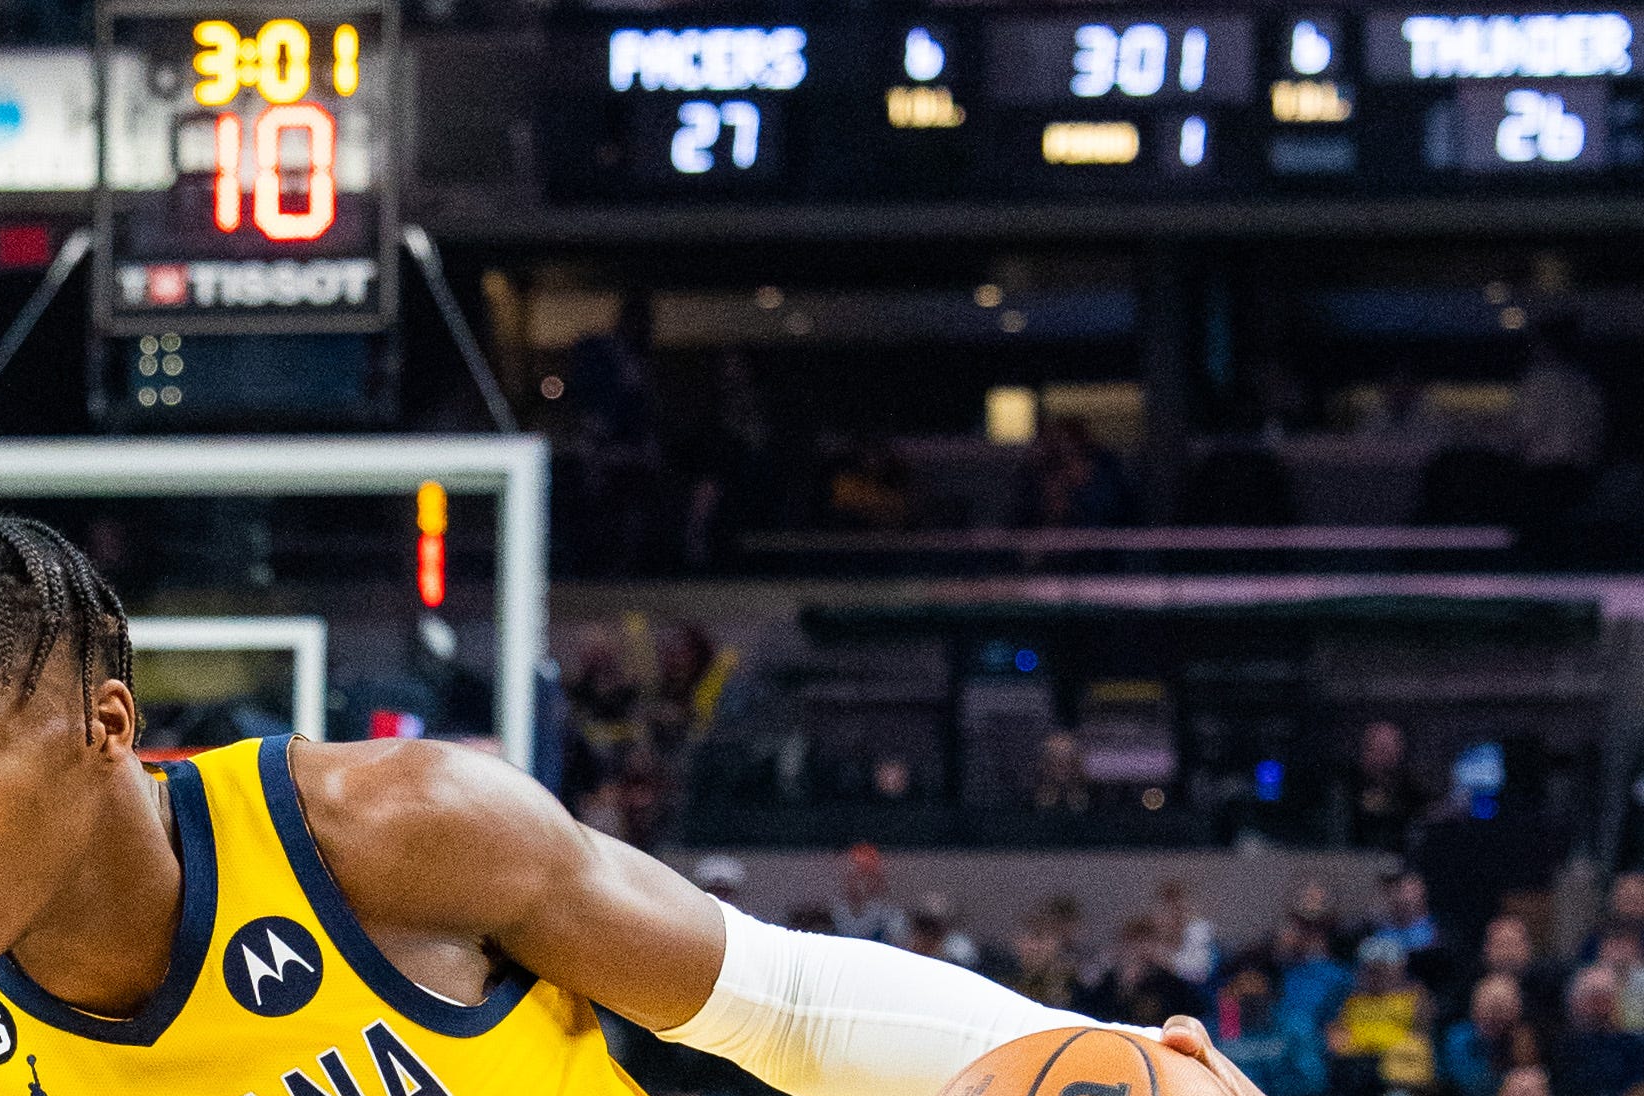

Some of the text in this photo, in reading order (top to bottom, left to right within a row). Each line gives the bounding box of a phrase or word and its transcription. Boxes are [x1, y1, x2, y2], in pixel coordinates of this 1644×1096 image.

[193, 20, 358, 106] 3:01
[671, 101, 761, 174] 27
[1179, 115, 1207, 167] 1
[1496, 88, 1586, 162] 26
[213, 102, 337, 241] 10
